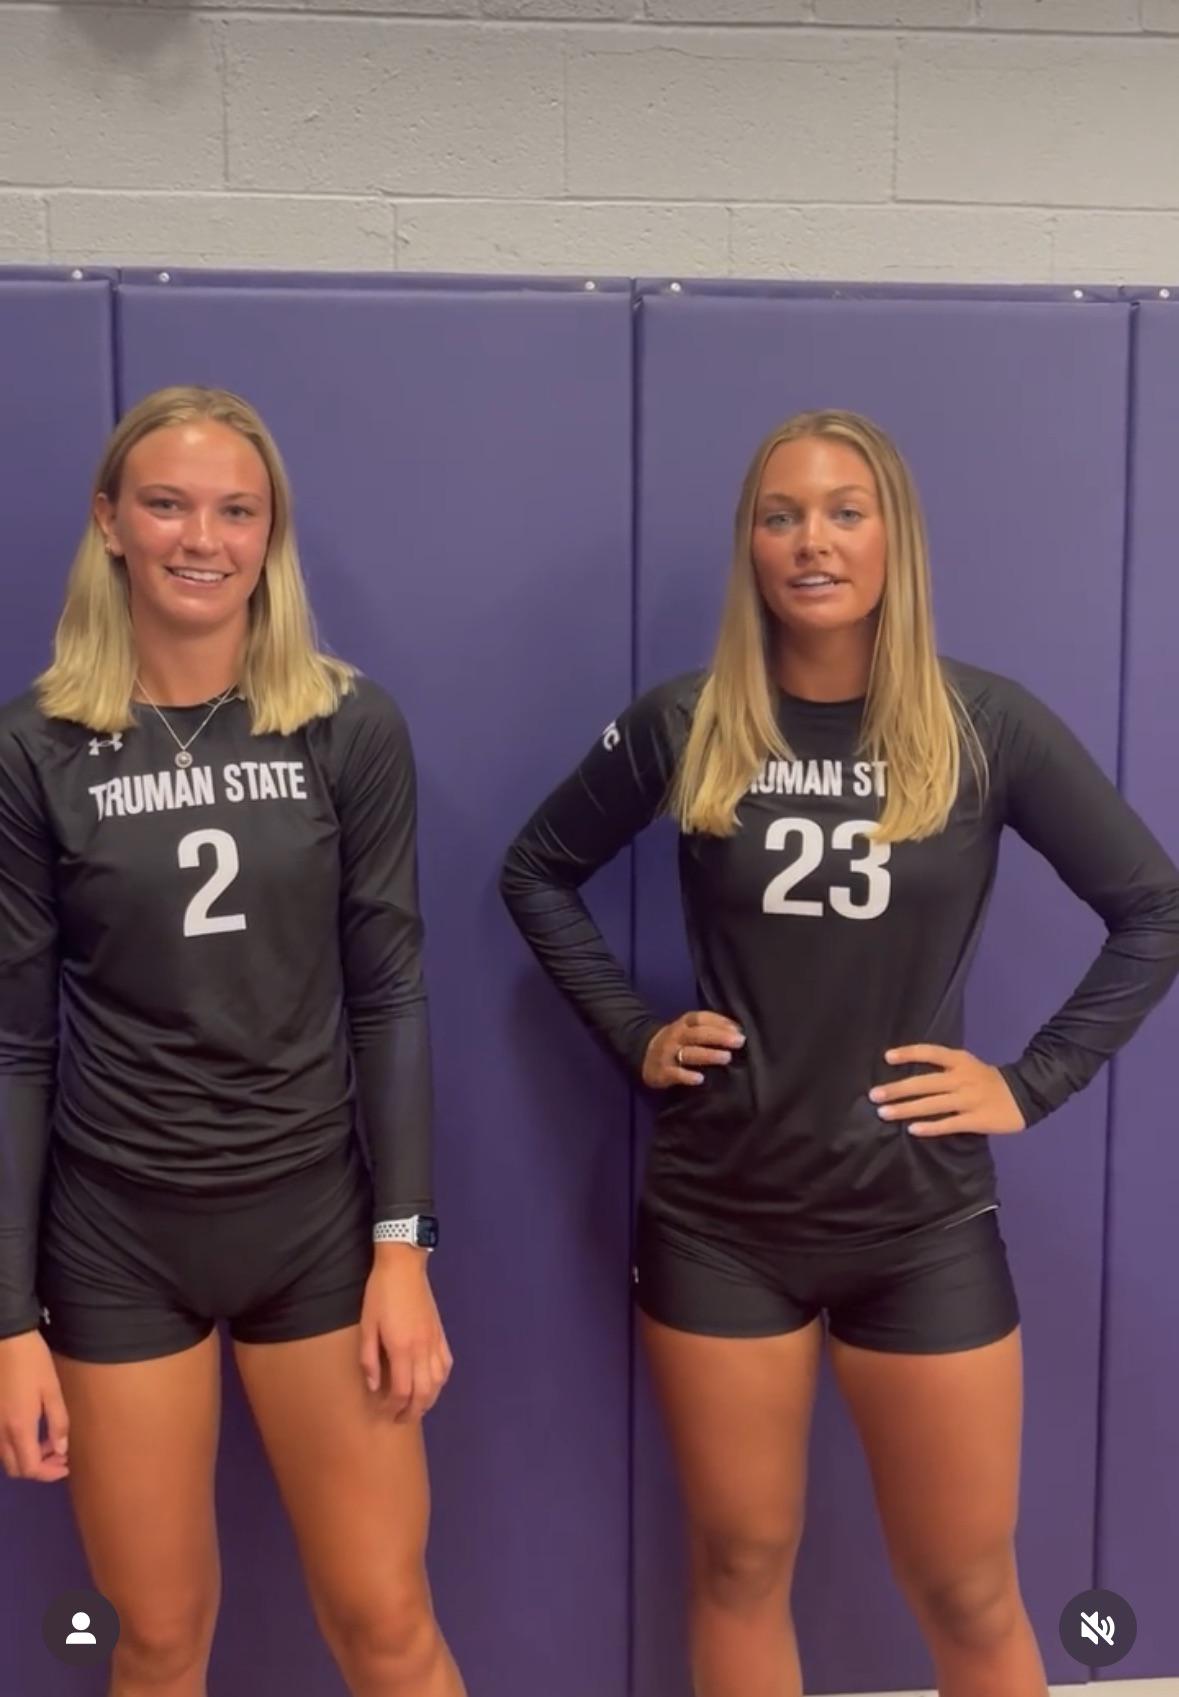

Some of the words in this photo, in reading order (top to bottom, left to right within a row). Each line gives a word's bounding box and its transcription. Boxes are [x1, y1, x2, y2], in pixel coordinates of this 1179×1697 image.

[88, 766, 215, 821] TRUMAN
[223, 761, 307, 802] STATE
[853, 760, 888, 797] ST
[177, 828, 246, 937] 2
[762, 816, 892, 920] 23
